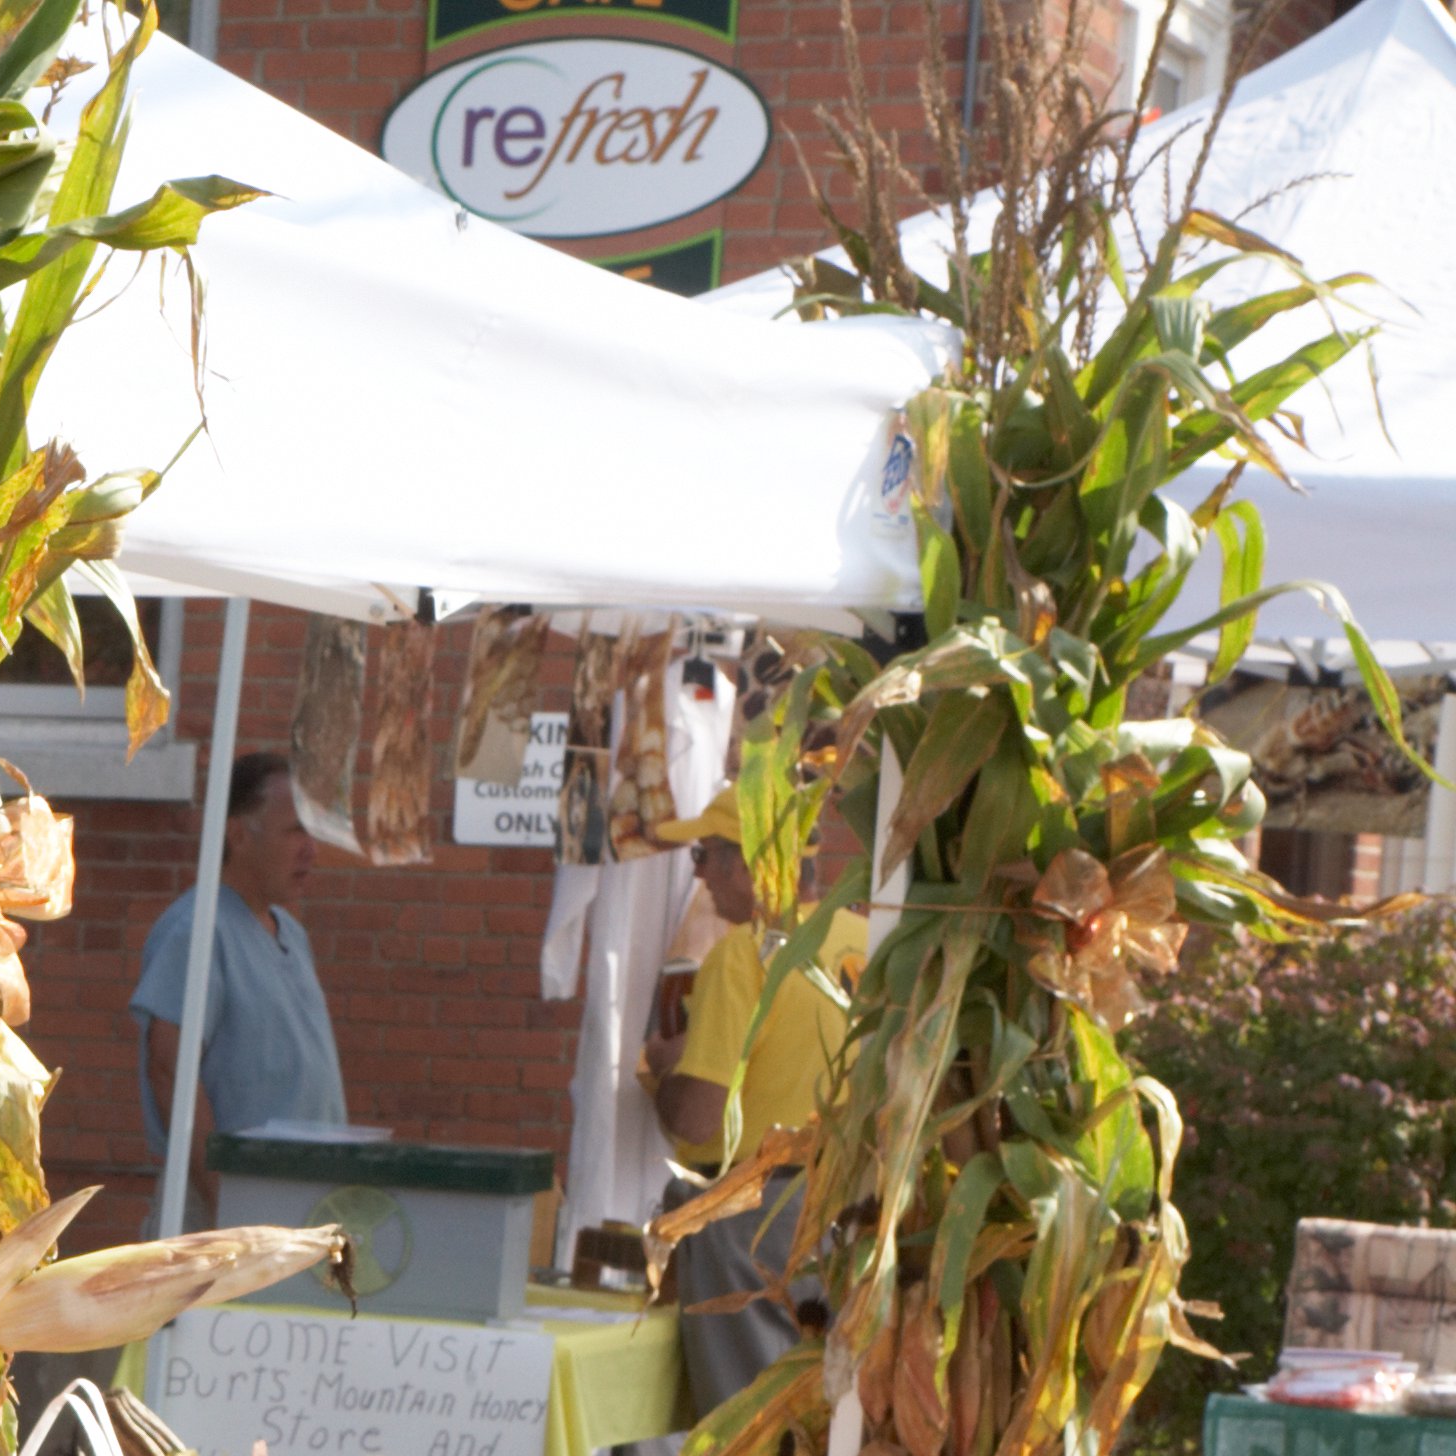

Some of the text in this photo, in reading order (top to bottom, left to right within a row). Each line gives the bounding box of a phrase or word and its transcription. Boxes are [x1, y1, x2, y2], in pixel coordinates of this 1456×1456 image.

[461, 70, 720, 199] refresh
[262, 1404, 383, 1452] Store
[469, 1391, 547, 1425] Honey
